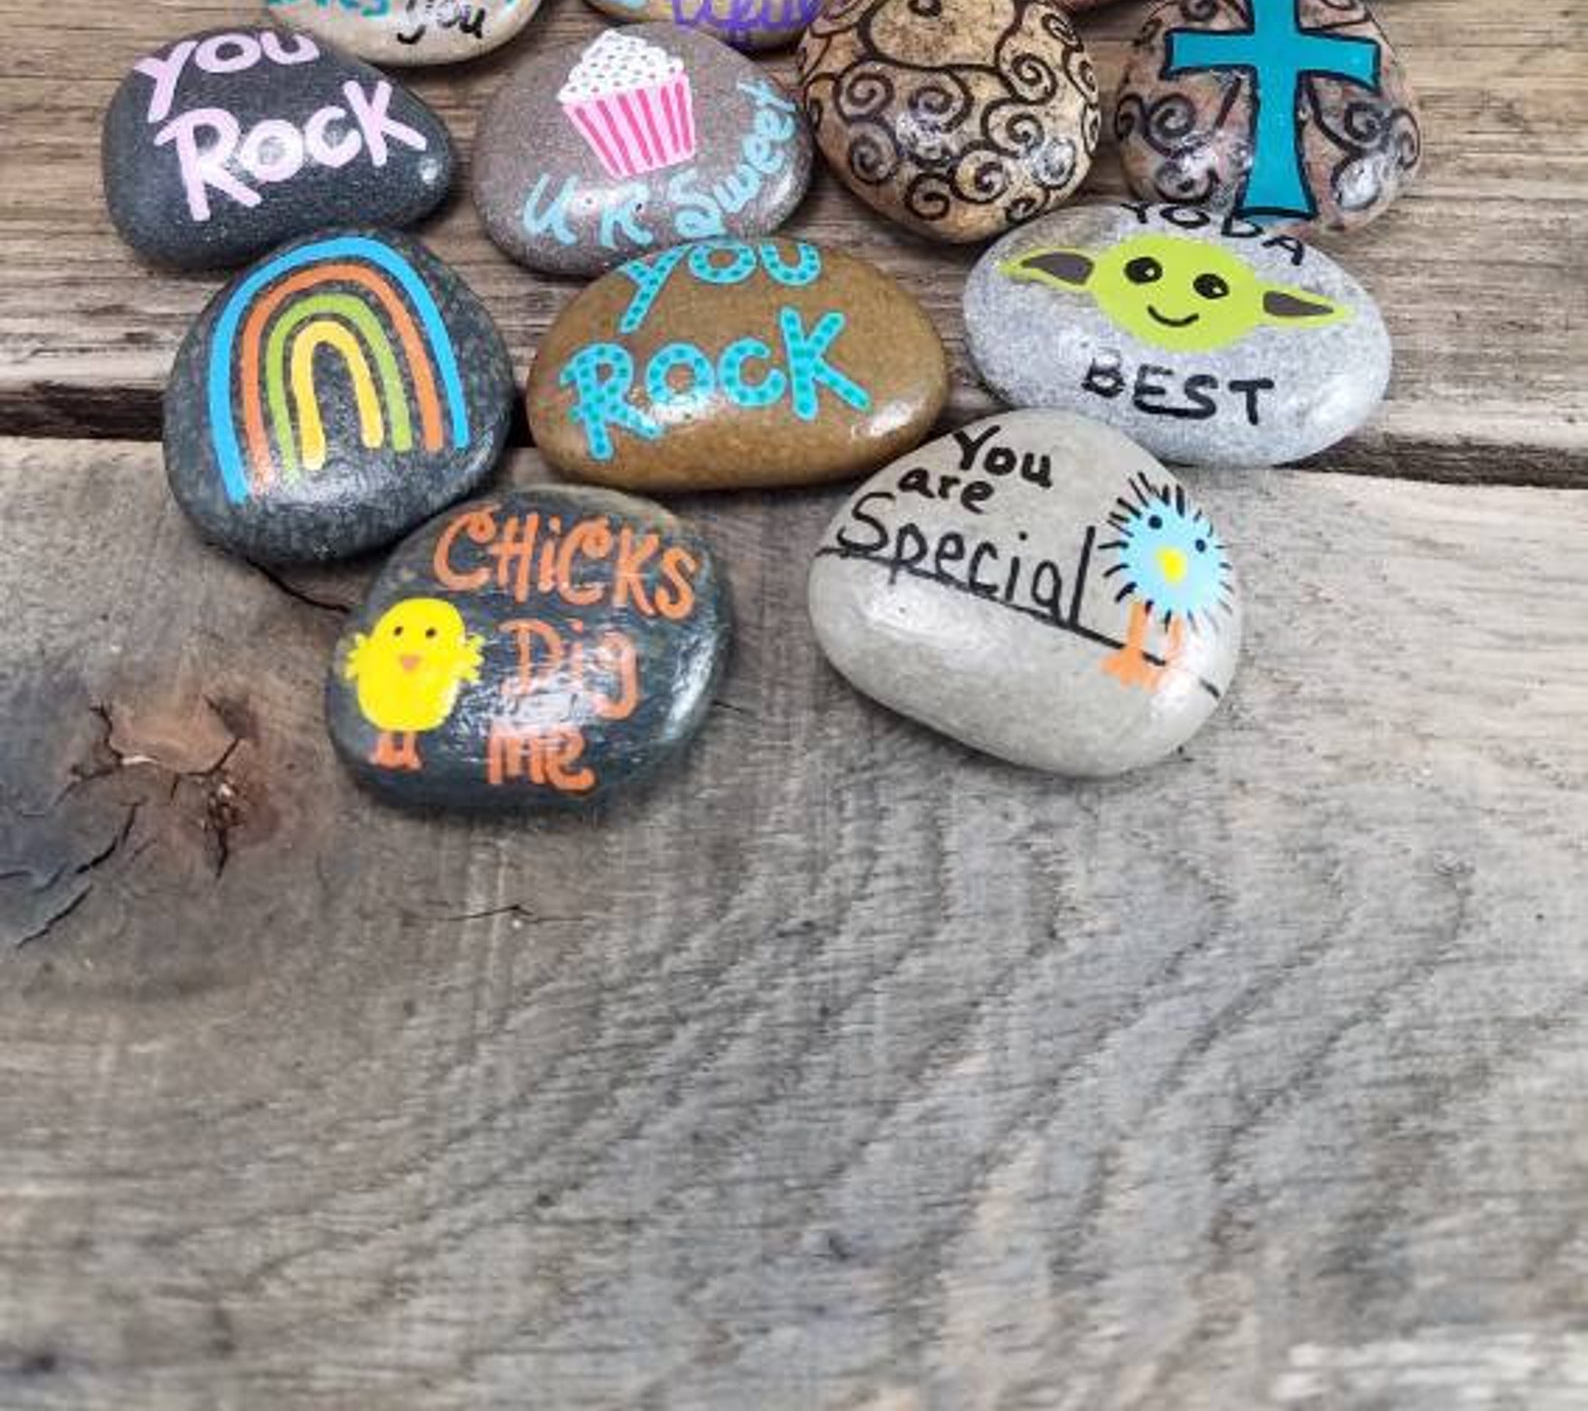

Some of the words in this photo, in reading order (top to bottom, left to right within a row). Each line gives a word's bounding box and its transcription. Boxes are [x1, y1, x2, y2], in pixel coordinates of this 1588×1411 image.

[600, 182, 655, 249] R
[1120, 202, 1305, 267] YODA
[1080, 346, 1276, 426] BEST
[952, 424, 1052, 489] You
[897, 466, 995, 514] are
[836, 490, 1096, 628] Special
